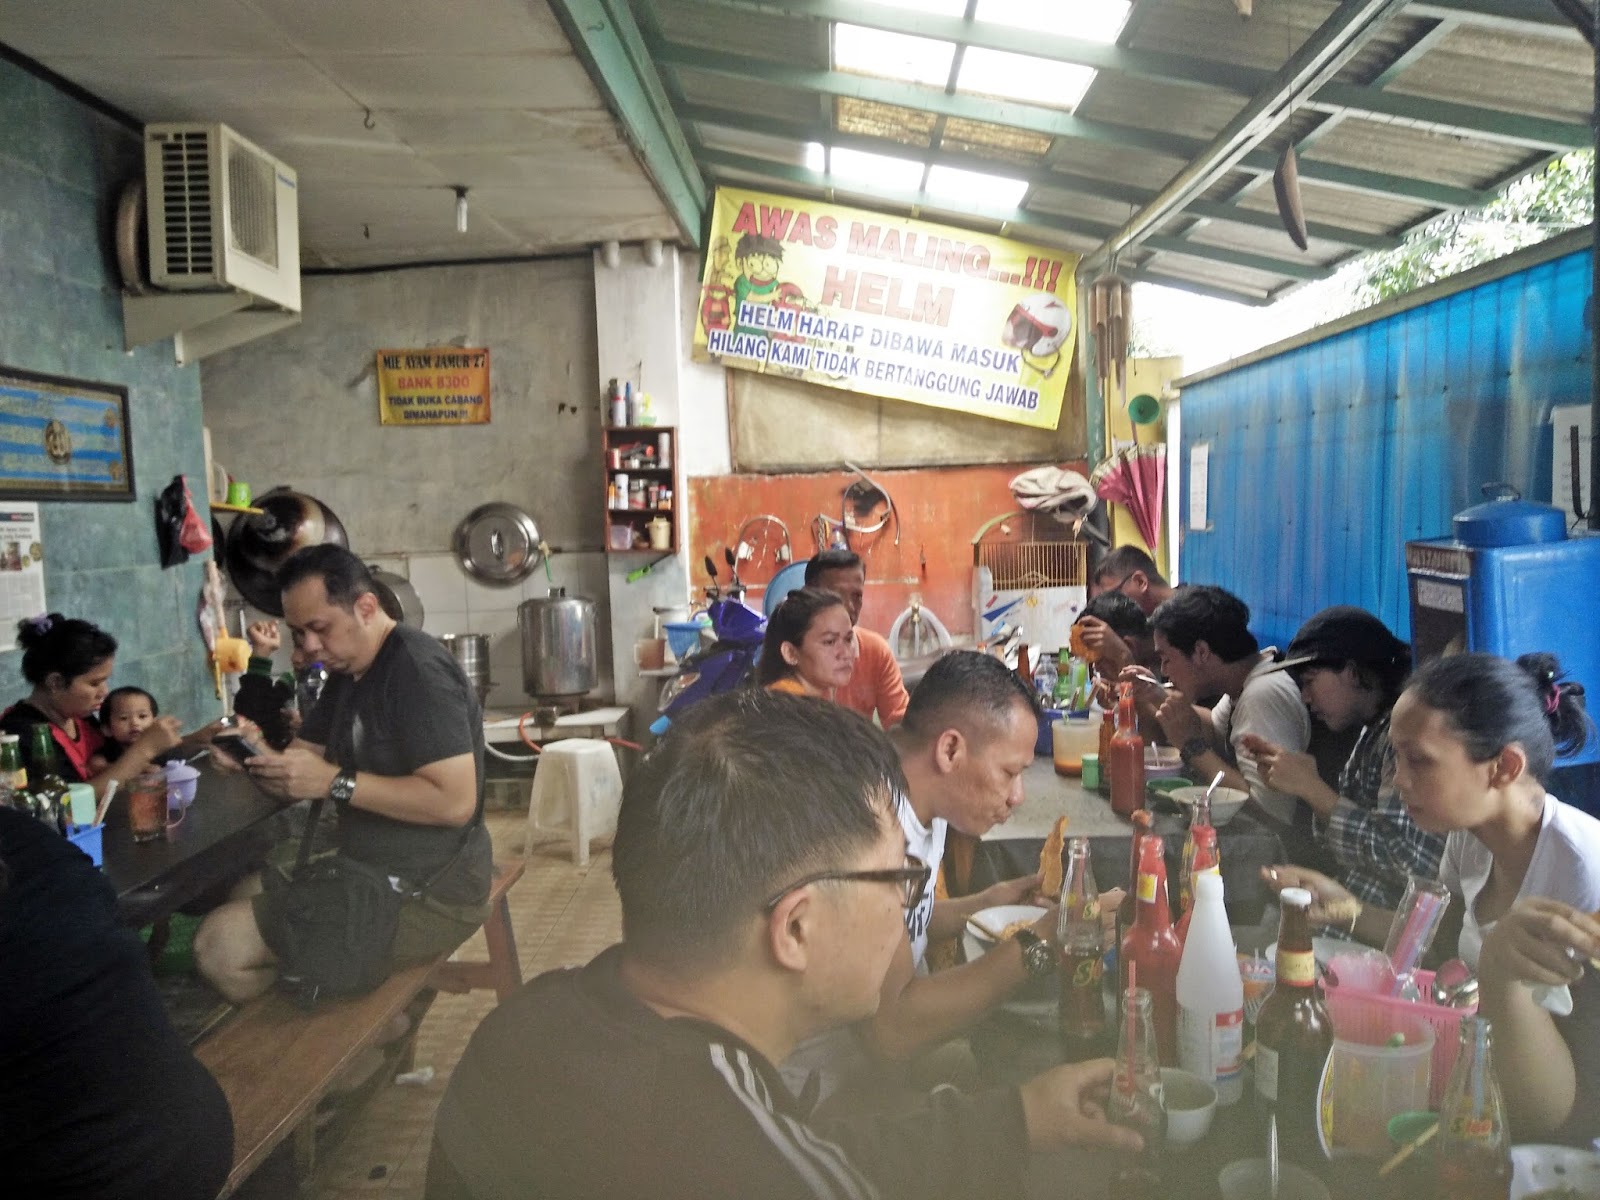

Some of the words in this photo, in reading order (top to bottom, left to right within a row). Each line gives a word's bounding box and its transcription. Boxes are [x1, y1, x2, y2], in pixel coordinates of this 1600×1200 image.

[731, 201, 839, 250] AWAS
[820, 264, 956, 328] HELM
[739, 303, 794, 331] HELM
[799, 314, 865, 344] HARAP
[870, 327, 943, 359] DIBAWA
[950, 343, 1021, 374] MASUK
[383, 355, 401, 369] MIE
[405, 355, 431, 369] AYAM
[435, 354, 470, 369] JAMUR
[709, 331, 767, 358] HILANG
[771, 341, 811, 368] KAMI
[815, 349, 861, 376] TIDAK
[865, 359, 981, 398] BERTANGGUNG
[985, 382, 1039, 410] JAWAB
[399, 376, 432, 389] BANK
[388, 396, 413, 405] TIDAK
[417, 396, 441, 405] BUKA
[445, 395, 483, 405] CABANG
[404, 410, 457, 419] DIMANAPUN
